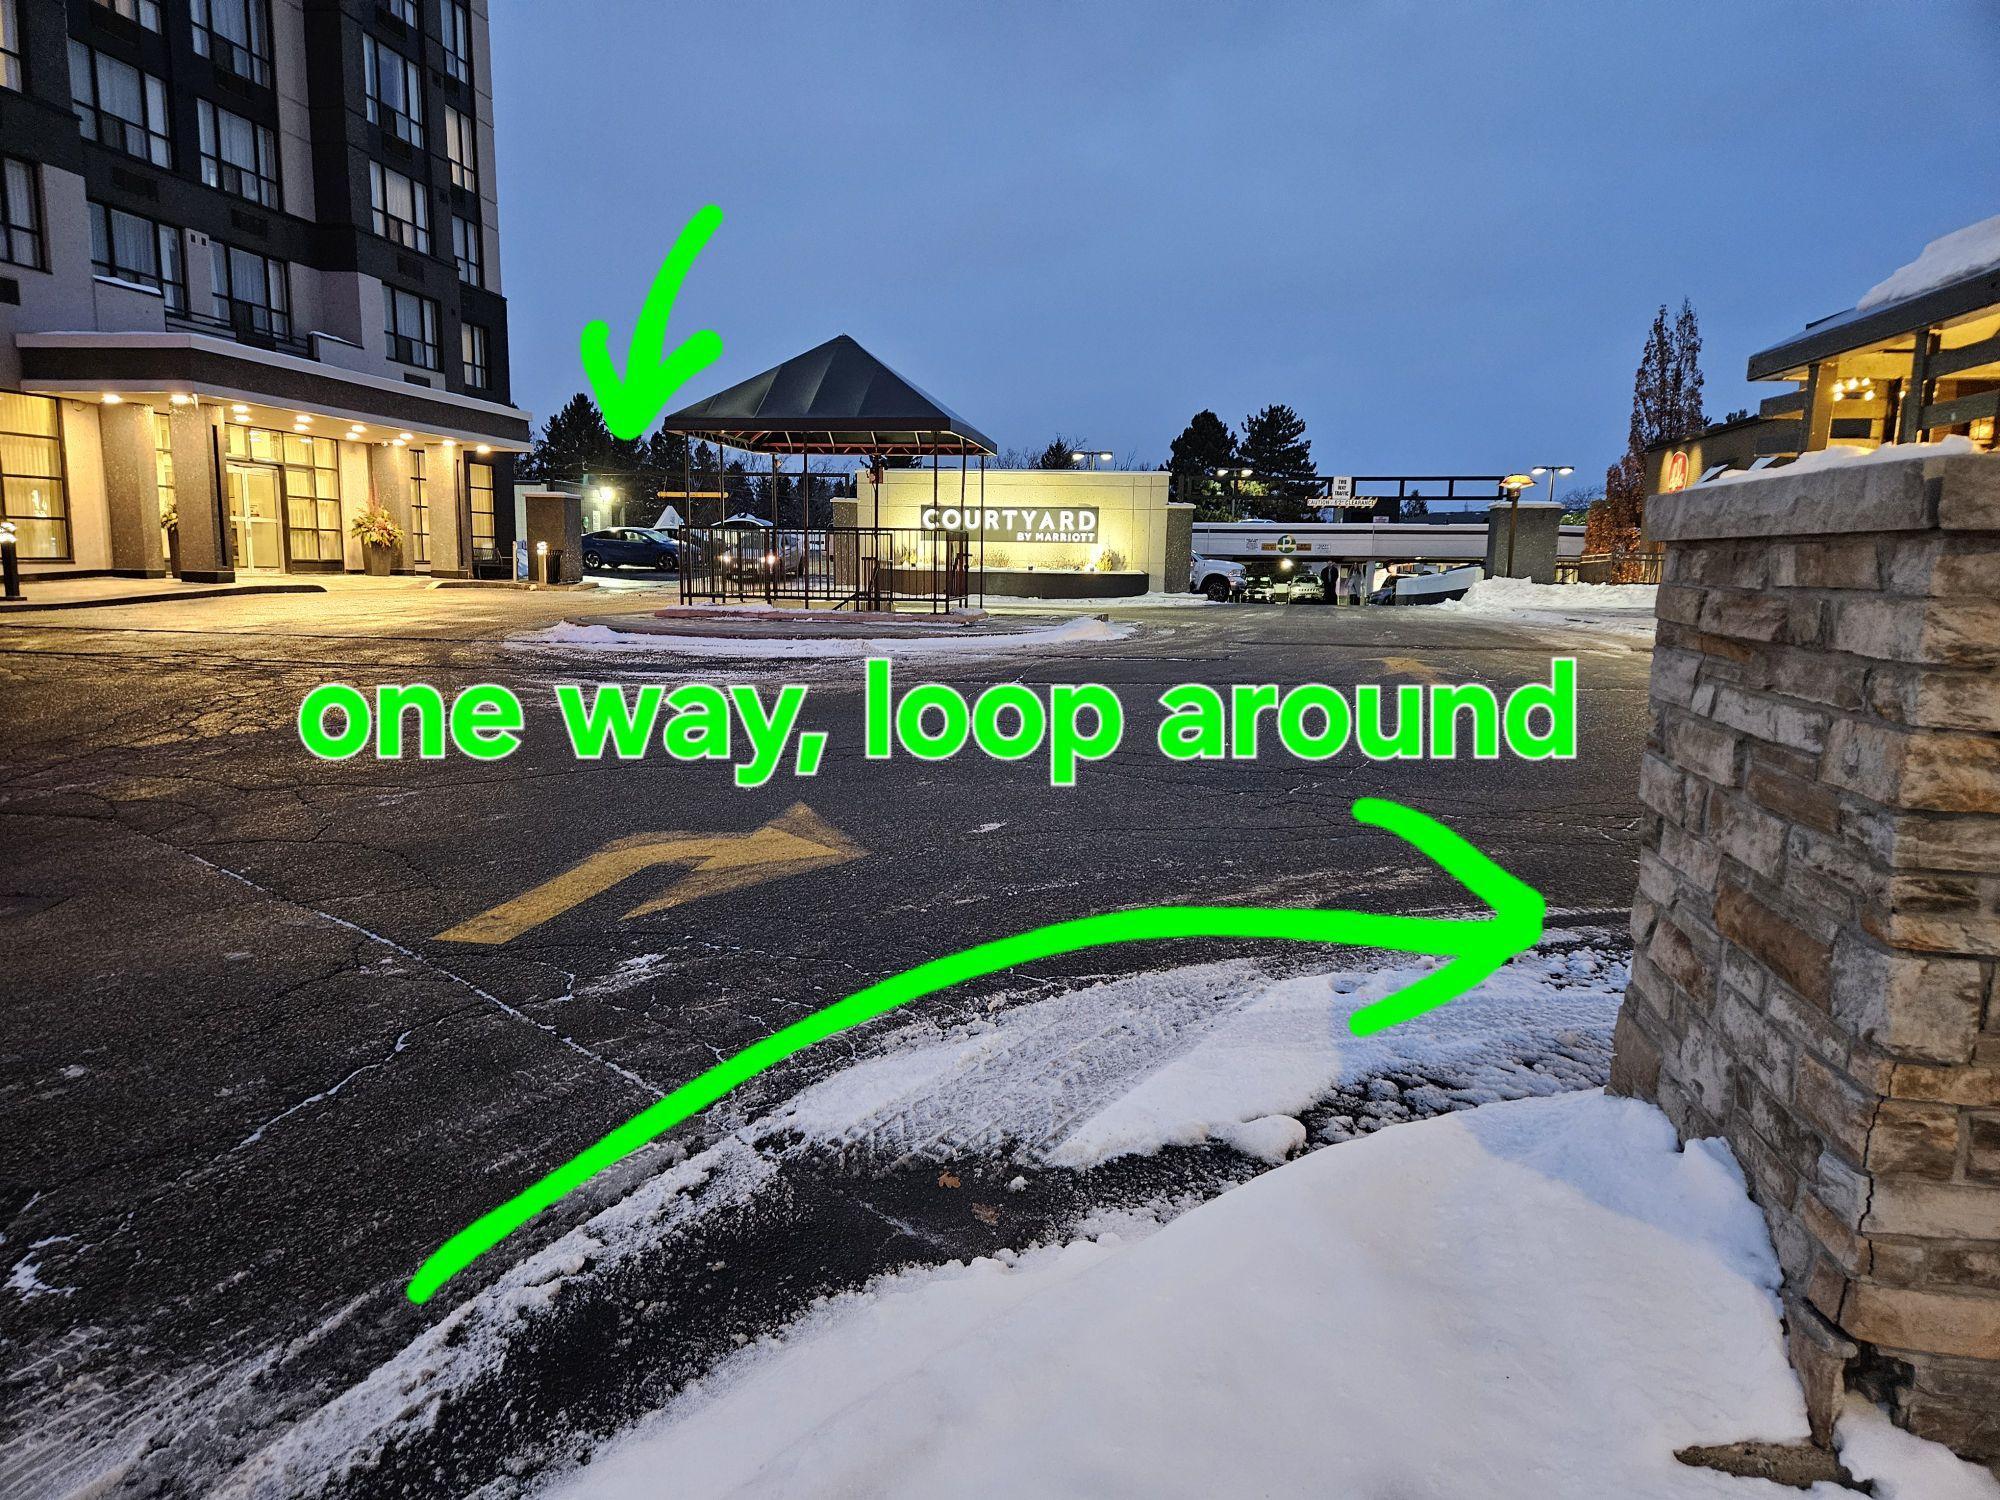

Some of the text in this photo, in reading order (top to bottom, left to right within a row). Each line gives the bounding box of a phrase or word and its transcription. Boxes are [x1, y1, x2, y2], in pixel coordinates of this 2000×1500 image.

[922, 508, 1096, 531] COURTYARD
[1016, 531, 1095, 542] BY MARRIOTT
